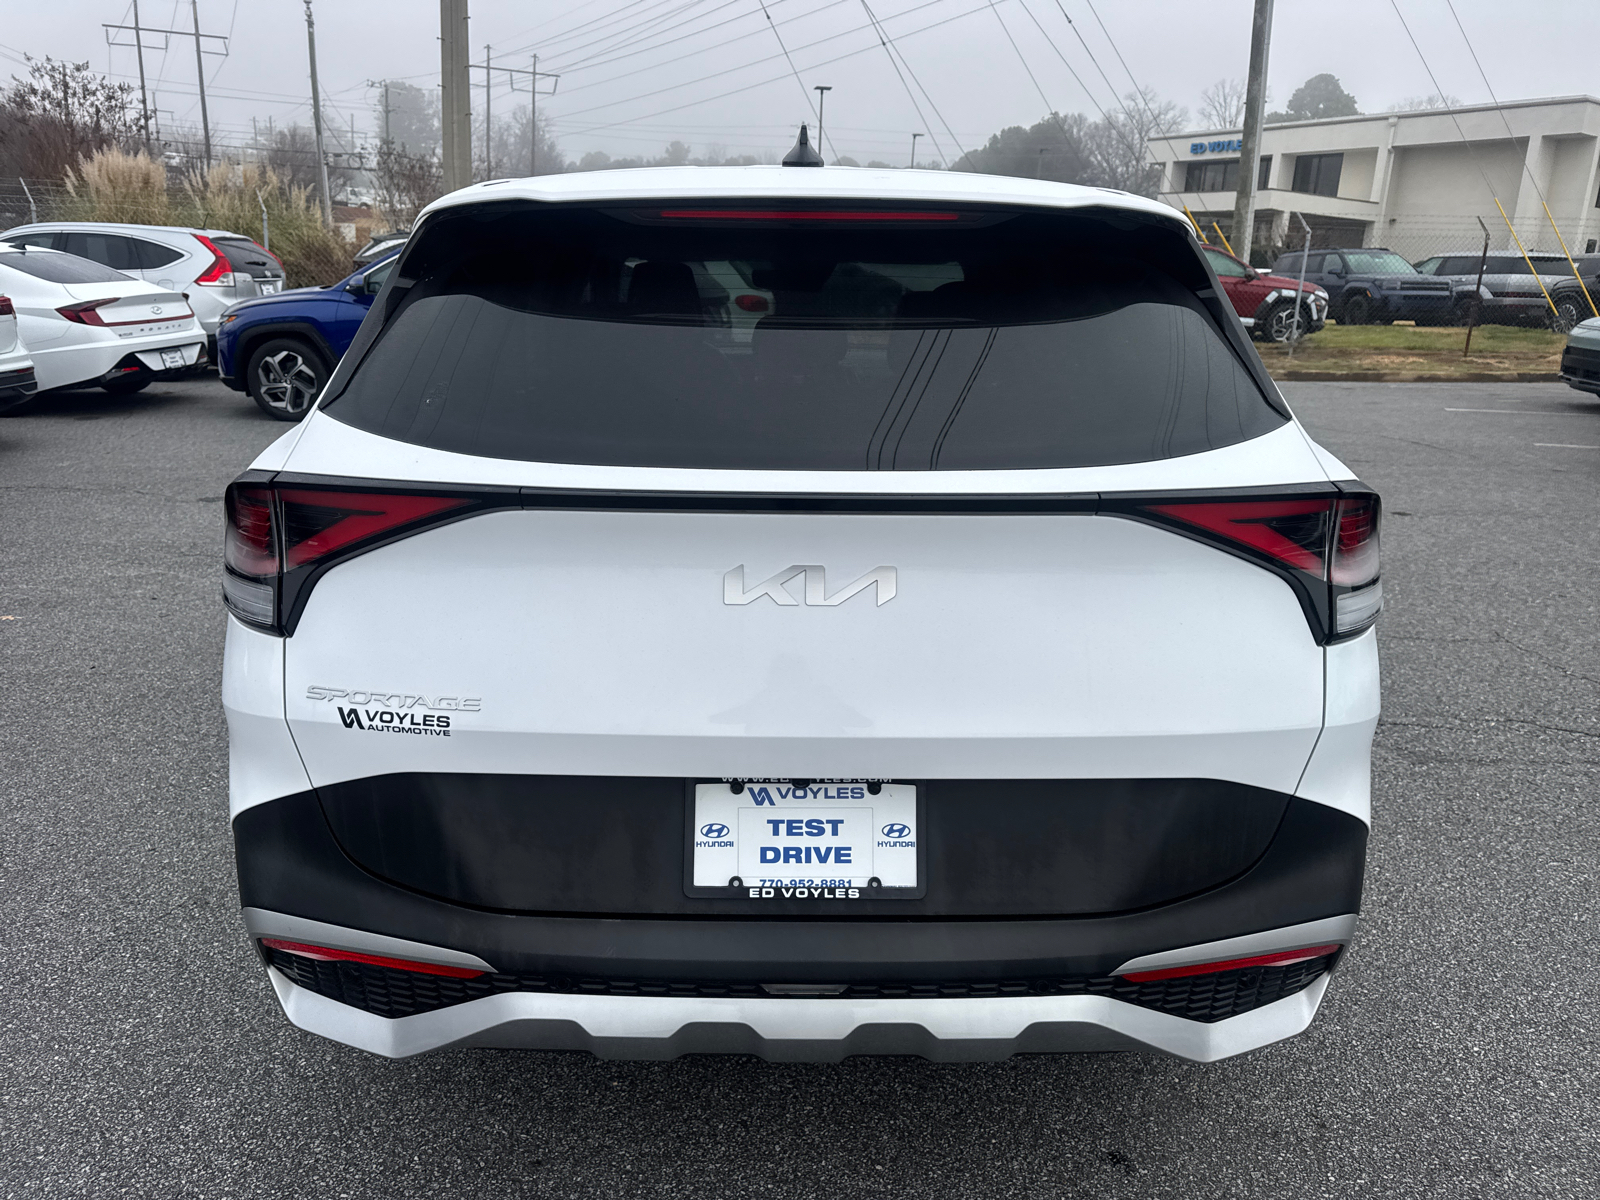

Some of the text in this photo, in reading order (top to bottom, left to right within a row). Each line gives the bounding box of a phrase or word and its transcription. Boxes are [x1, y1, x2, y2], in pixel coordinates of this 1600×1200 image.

[1190, 139, 1242, 154] ED VOYLE
[723, 564, 898, 607] KIA
[306, 685, 481, 712] SPORTAGE
[365, 709, 451, 728] VOYLES
[367, 724, 451, 737] AUTOMOTIVE
[776, 787, 865, 799] VOYLES
[767, 819, 844, 837] TEST
[760, 846, 852, 864] DRIVE
[759, 879, 852, 887] 770-952-8881
[749, 888, 860, 898] ED VOYLES
